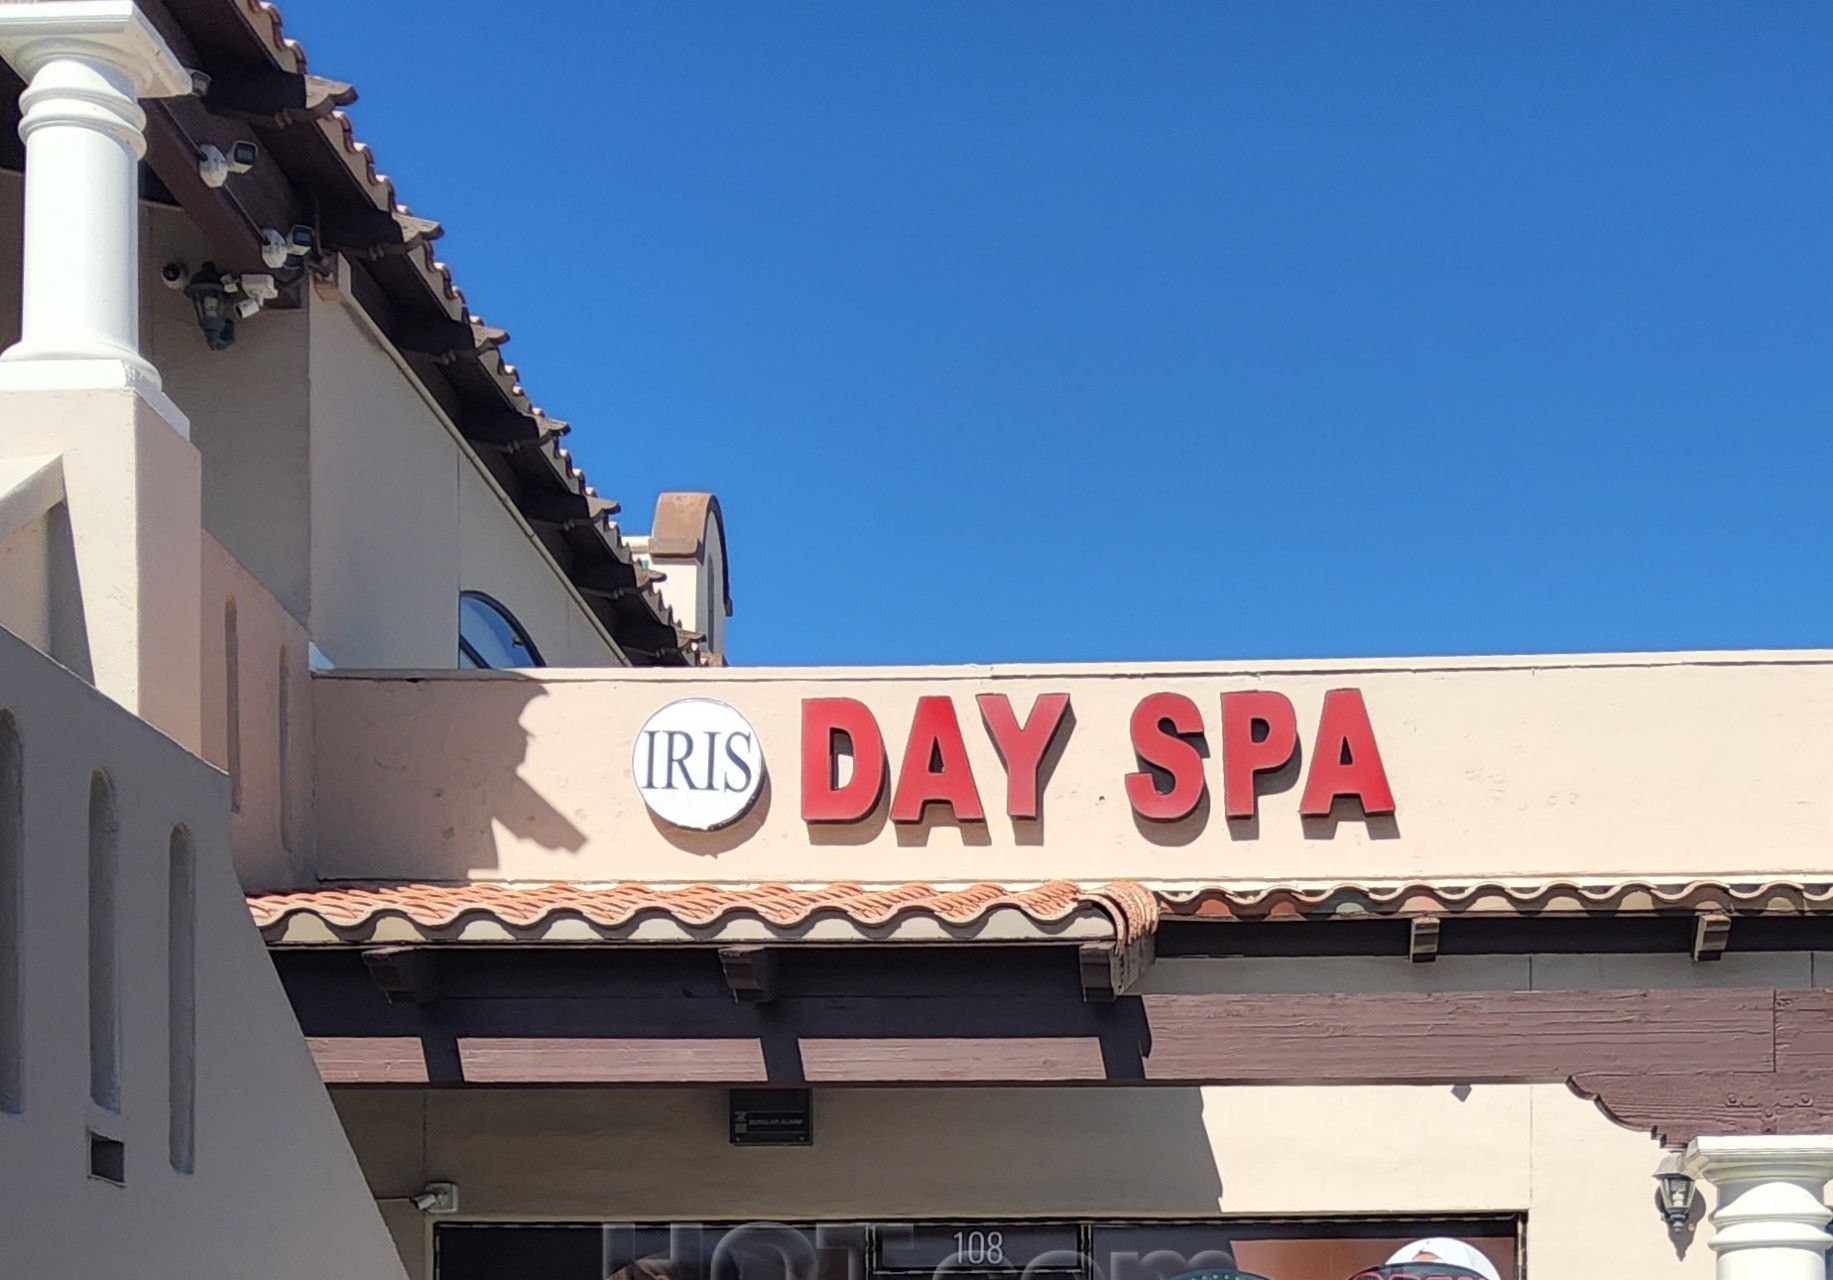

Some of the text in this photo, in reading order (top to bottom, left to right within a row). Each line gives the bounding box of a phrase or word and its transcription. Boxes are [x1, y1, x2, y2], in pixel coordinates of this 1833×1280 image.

[641, 688, 1396, 823] IRIS DAY SPA
[953, 1231, 1004, 1265] 108
